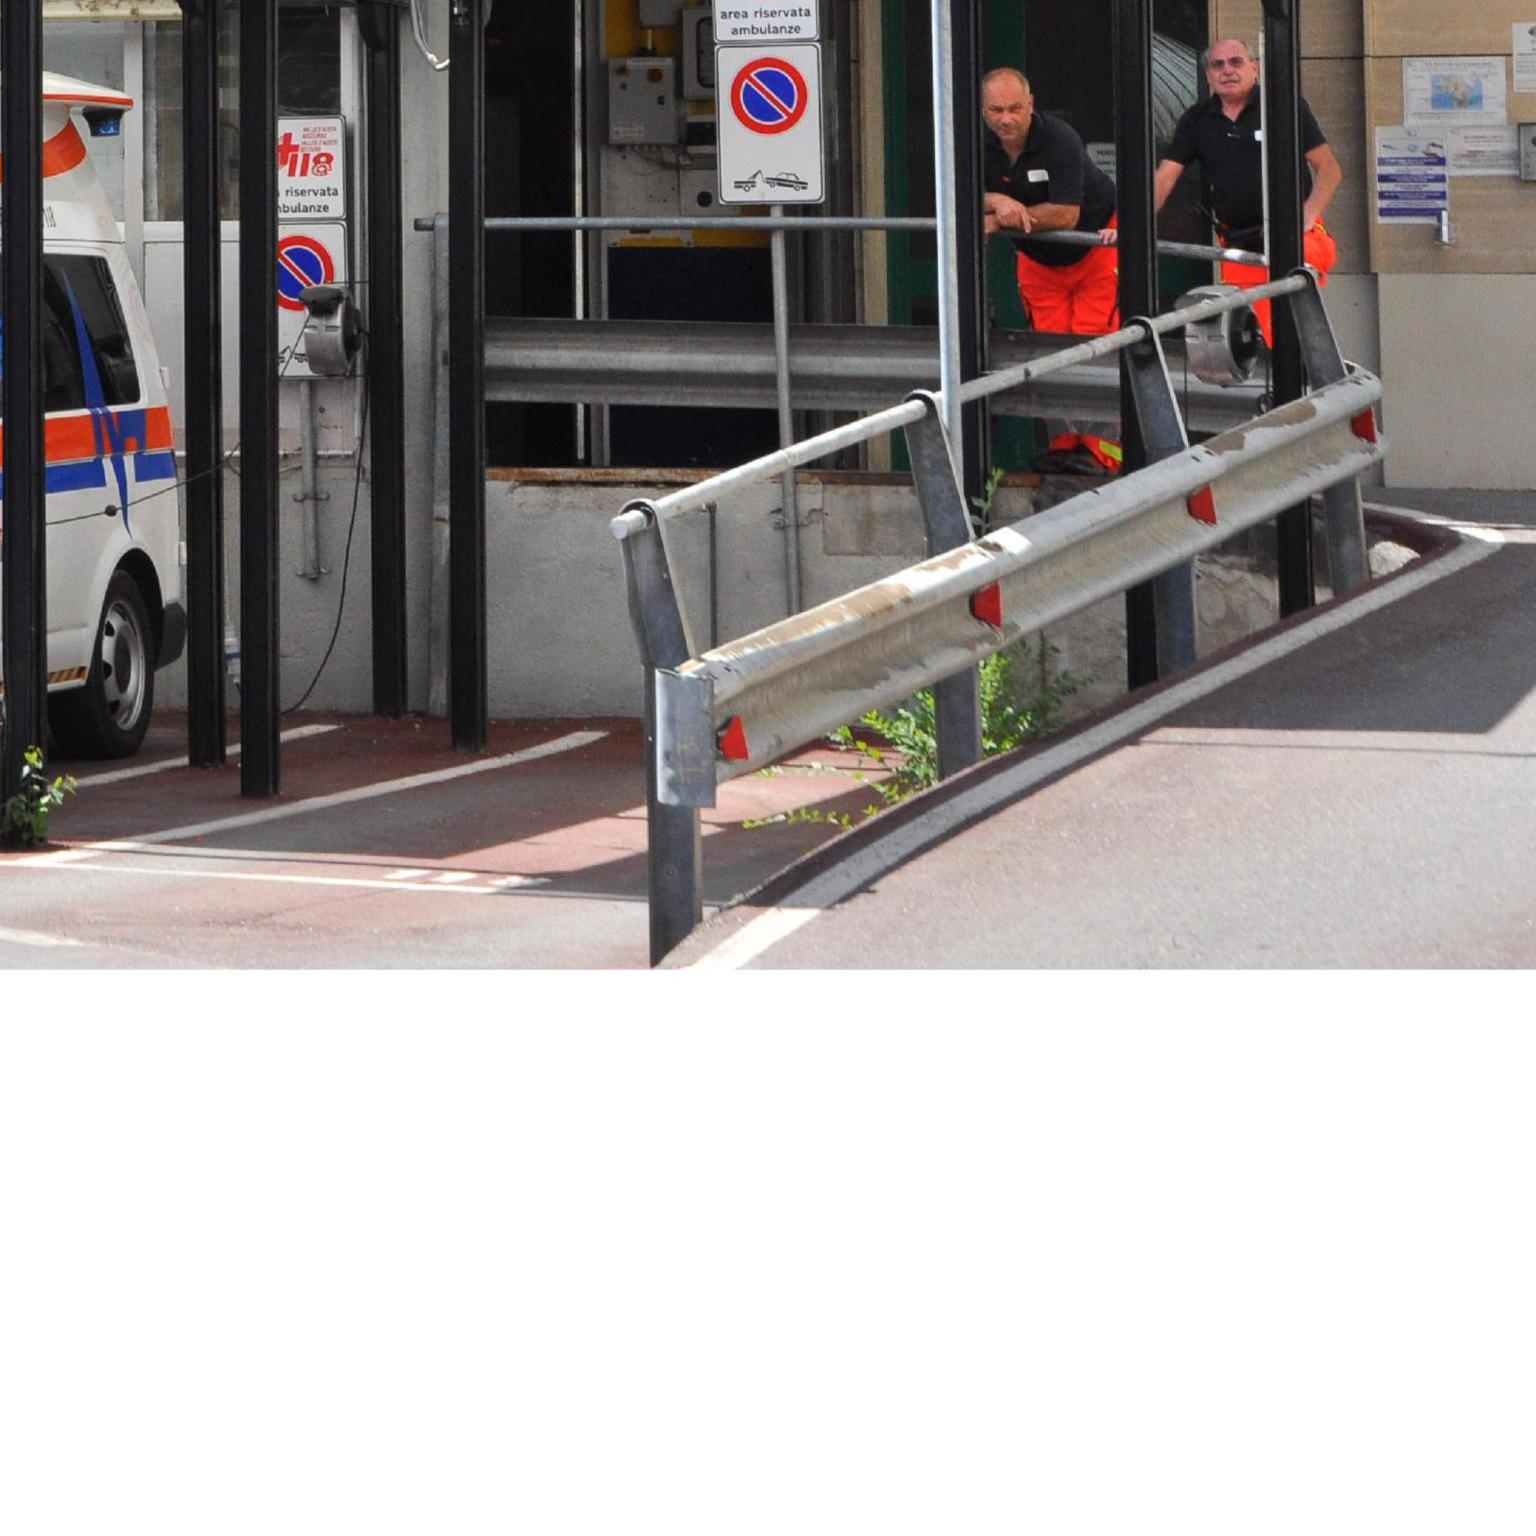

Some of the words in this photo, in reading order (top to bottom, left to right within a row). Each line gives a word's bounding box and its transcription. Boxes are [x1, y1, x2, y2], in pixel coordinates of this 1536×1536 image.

[720, 9, 749, 20] area
[754, 7, 811, 19] riservata
[731, 23, 801, 36] ambulanze
[285, 186, 339, 197] riservata
